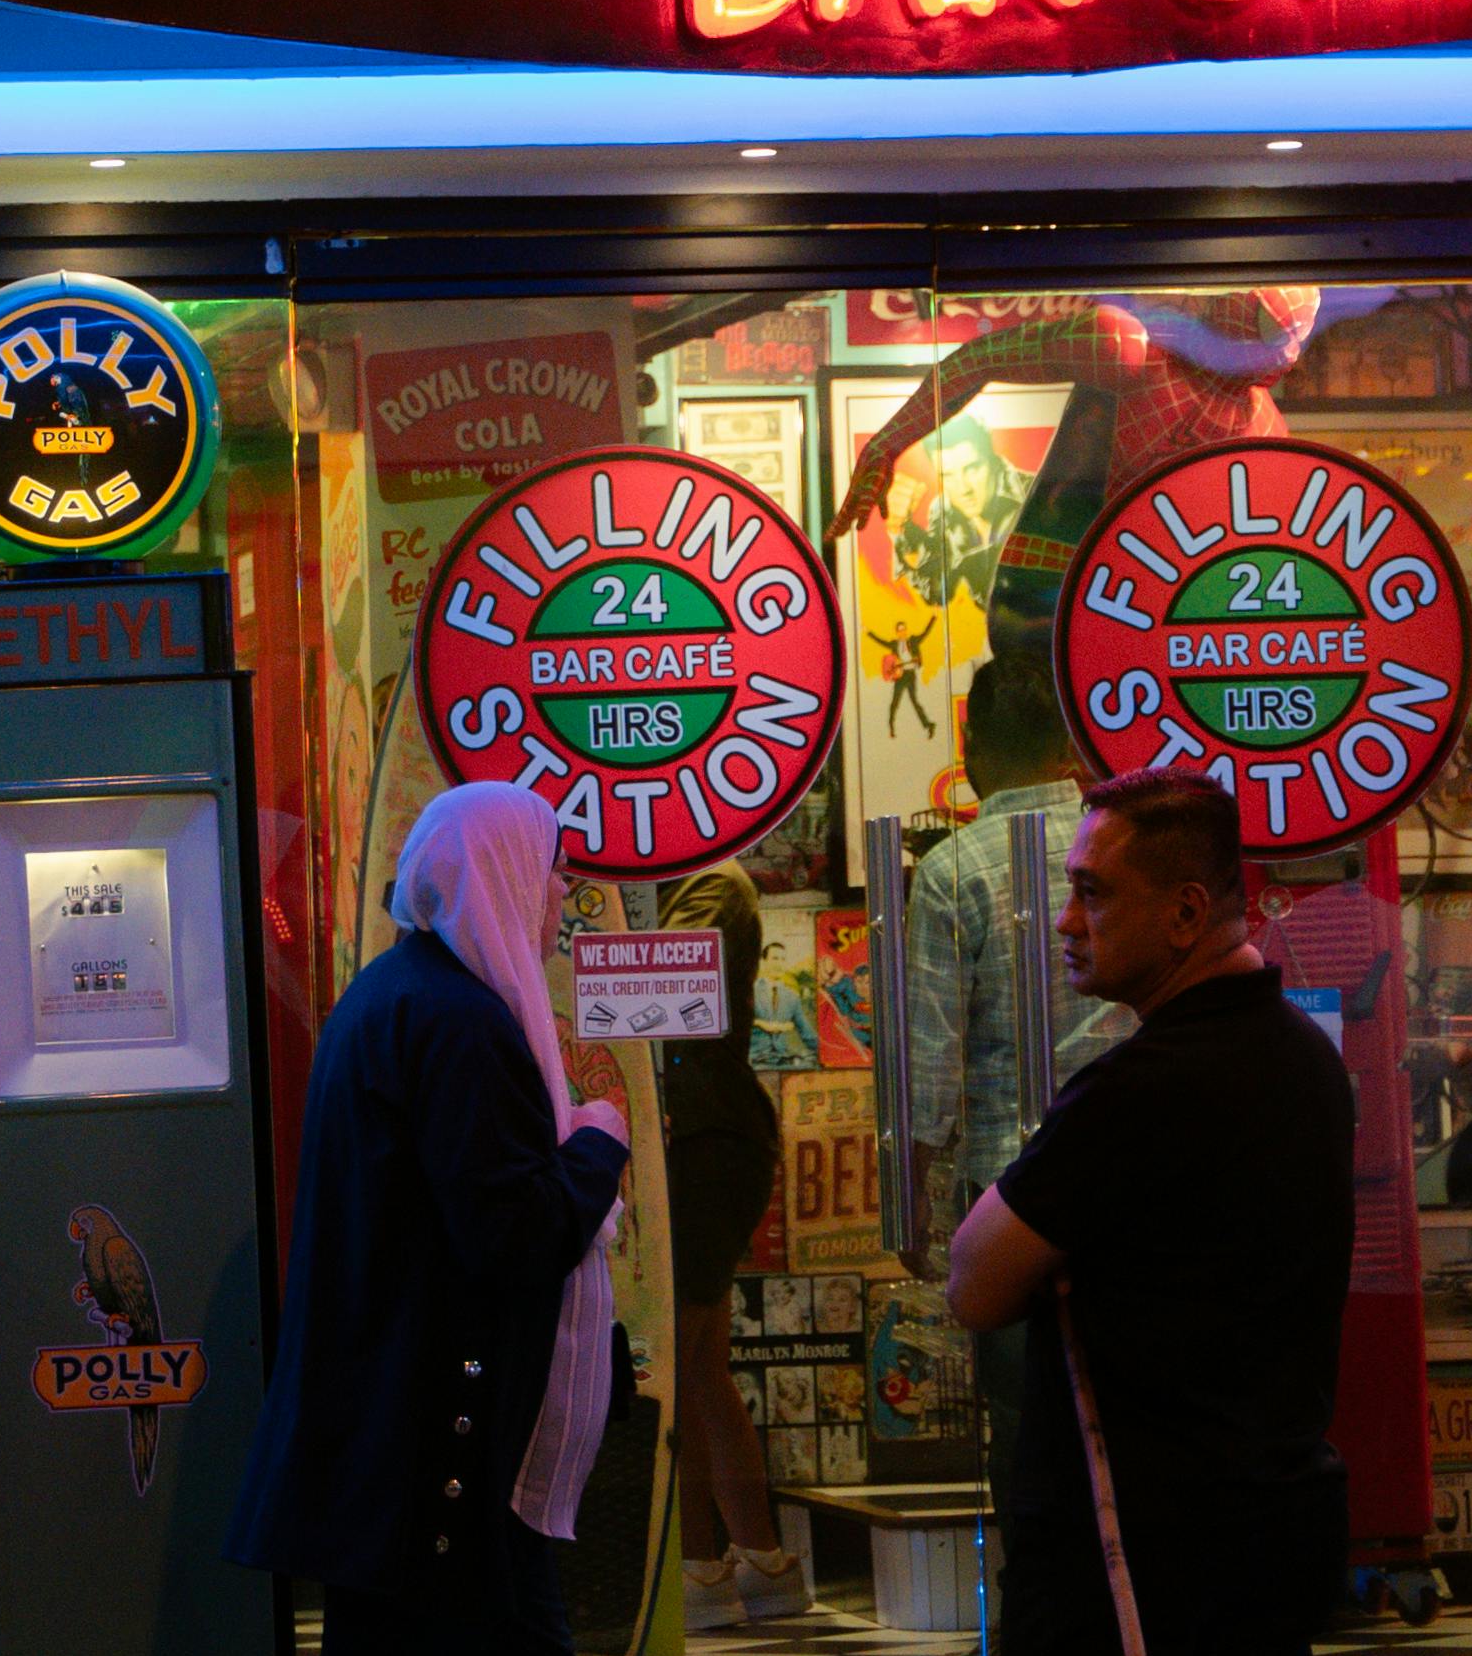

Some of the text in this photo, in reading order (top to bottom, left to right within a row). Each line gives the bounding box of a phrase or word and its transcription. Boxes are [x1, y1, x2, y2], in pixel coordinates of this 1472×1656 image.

[376, 357, 612, 437] ROYAL CROWN
[41, 429, 107, 447] POLLY
[454, 412, 544, 453] COLA
[7, 469, 143, 524] GAS
[410, 462, 486, 487] Best by
[381, 526, 430, 565] RC
[443, 470, 810, 648] FILLING
[1083, 459, 1440, 633] FILLING
[589, 572, 670, 628] 24
[1226, 560, 1304, 614] 24
[529, 634, 736, 685] BAR CAFÉ
[1166, 622, 1368, 669] BAR CAFÉ
[587, 701, 684, 750] HRS
[1223, 686, 1317, 733] HRS
[64, 882, 123, 898] THIS SALE
[71, 958, 129, 973] GALLONS
[580, 940, 714, 968] WE ONLY ACCEPT
[687, 978, 717, 994] CARD
[50, 1350, 191, 1395] POLLY
[792, 1341, 852, 1361] MONROE
[88, 1383, 152, 1401] GAS
